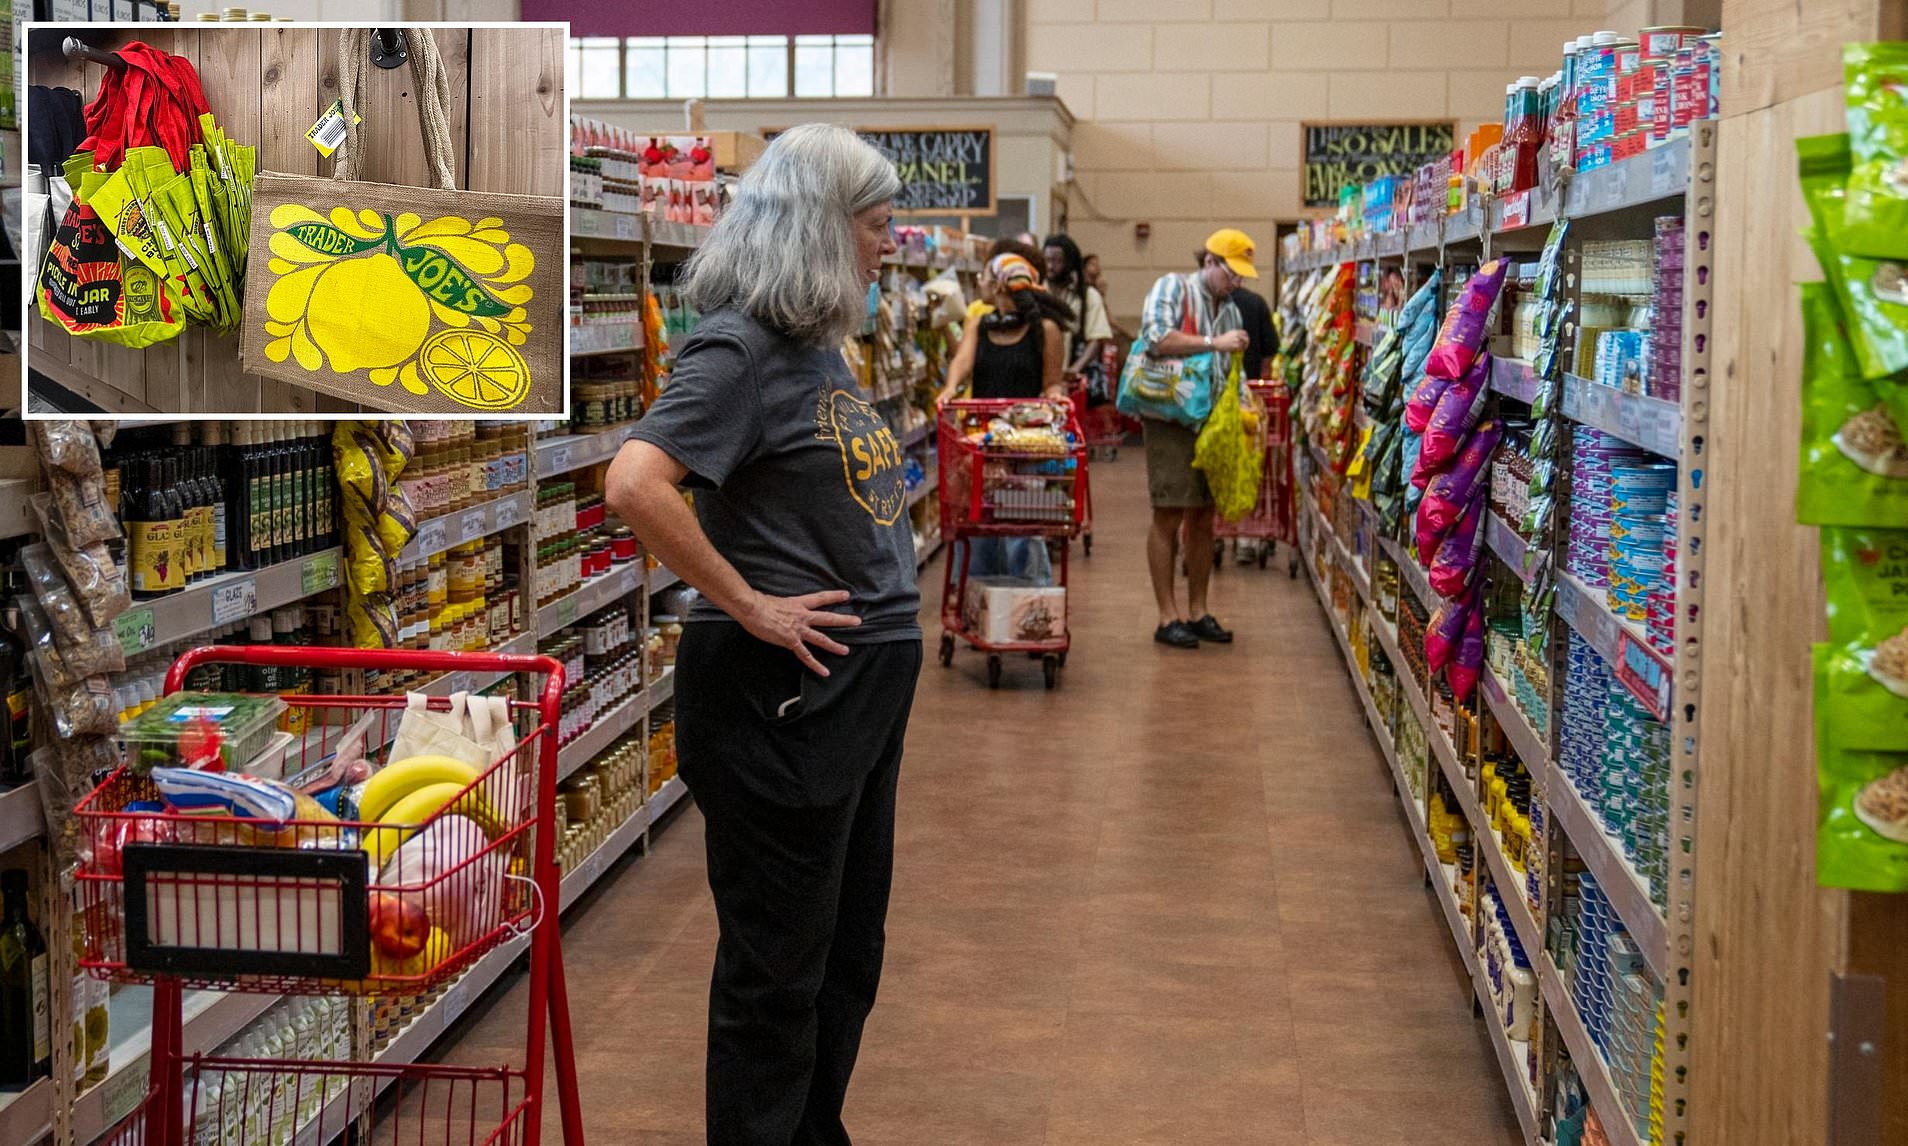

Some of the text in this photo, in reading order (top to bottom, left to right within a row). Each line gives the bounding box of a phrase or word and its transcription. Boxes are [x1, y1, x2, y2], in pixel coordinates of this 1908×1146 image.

[308, 117, 329, 139] TRADER
[47, 262, 68, 291] PICKLE
[297, 225, 485, 313] TRADER JOE'S
[78, 288, 110, 306] JAR
[80, 305, 99, 316] EARLY
[851, 426, 902, 480] SAFE
